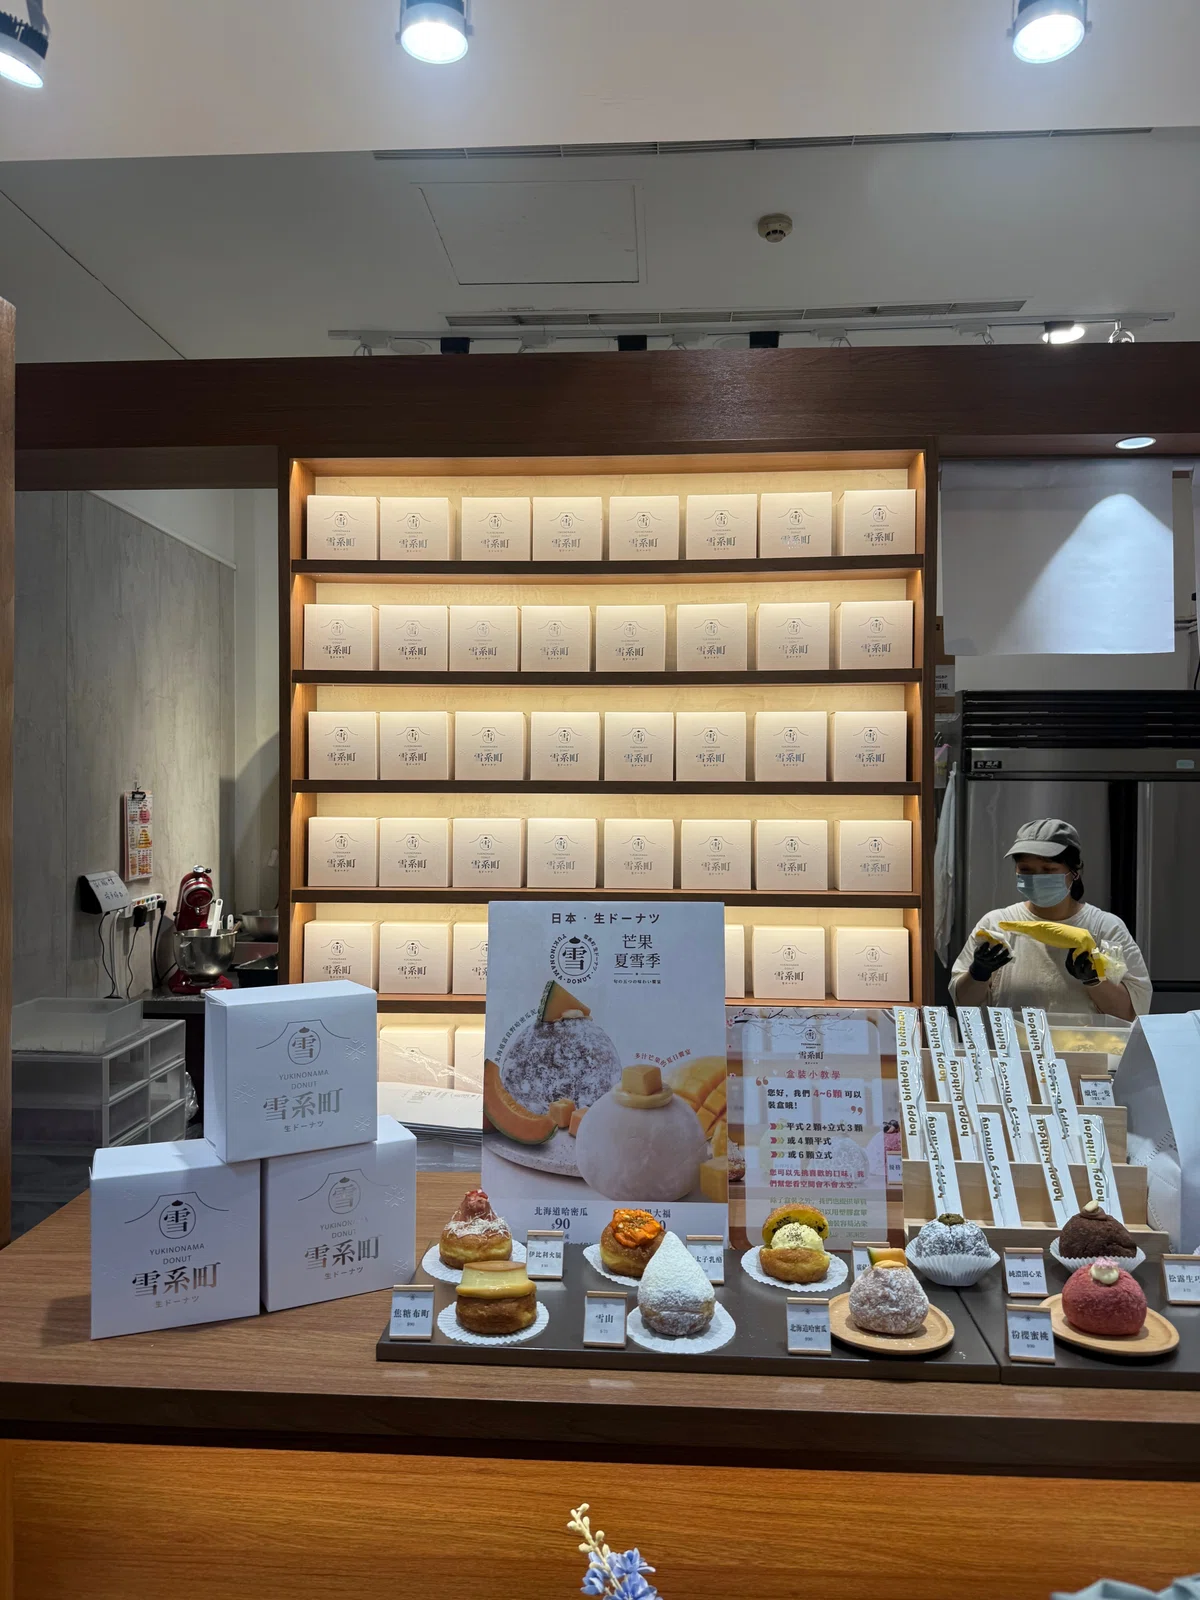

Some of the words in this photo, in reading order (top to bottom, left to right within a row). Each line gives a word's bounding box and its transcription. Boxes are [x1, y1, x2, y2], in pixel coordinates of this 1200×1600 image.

[622, 934, 653, 950] 芒果
[562, 946, 588, 971] 雪
[614, 953, 661, 969] 夏雪季
[928, 1010, 941, 1049] birthday
[994, 1011, 1007, 1050] birthday
[1027, 1012, 1041, 1051] birthday
[291, 1035, 317, 1060] 雪
[279, 1069, 329, 1081] YUKINONAMA
[786, 1069, 841, 1080] 盒裝小教學
[935, 1052, 947, 1082] happy
[291, 1080, 318, 1090] DONUT
[900, 1060, 912, 1101] birthday
[950, 1060, 962, 1102] birthday
[263, 1088, 344, 1122] 雪系町
[844, 1090, 862, 1099] 可以
[283, 1120, 325, 1133] 生ドーナツ
[906, 1104, 917, 1136] happy
[957, 1105, 969, 1137] happy
[1036, 1119, 1051, 1164] birthday
[1083, 1119, 1098, 1165] birthday
[332, 1184, 357, 1209] 雪
[1047, 1167, 1064, 1201] happy
[1092, 1168, 1105, 1202] happy
[163, 1208, 191, 1233] 雪
[534, 1207, 589, 1217] 北海道哈密瓜
[551, 1217, 571, 1230] $90
[149, 1243, 205, 1256] YUKINONAMA
[162, 1255, 192, 1265] DONUT
[304, 1233, 384, 1270] 雪系町
[695, 1255, 723, 1264] 太子乳酪
[132, 1261, 221, 1297] 雪系町
[324, 1266, 364, 1280] 生ドーナツ
[155, 1295, 199, 1309] 生ドーナツ
[393, 1308, 430, 1319] 焦糖布町
[595, 1313, 614, 1324] 雪山
[789, 1323, 827, 1333] 北海道哈密瓜
[1011, 1329, 1049, 1341] 粉櫻蜜桃
